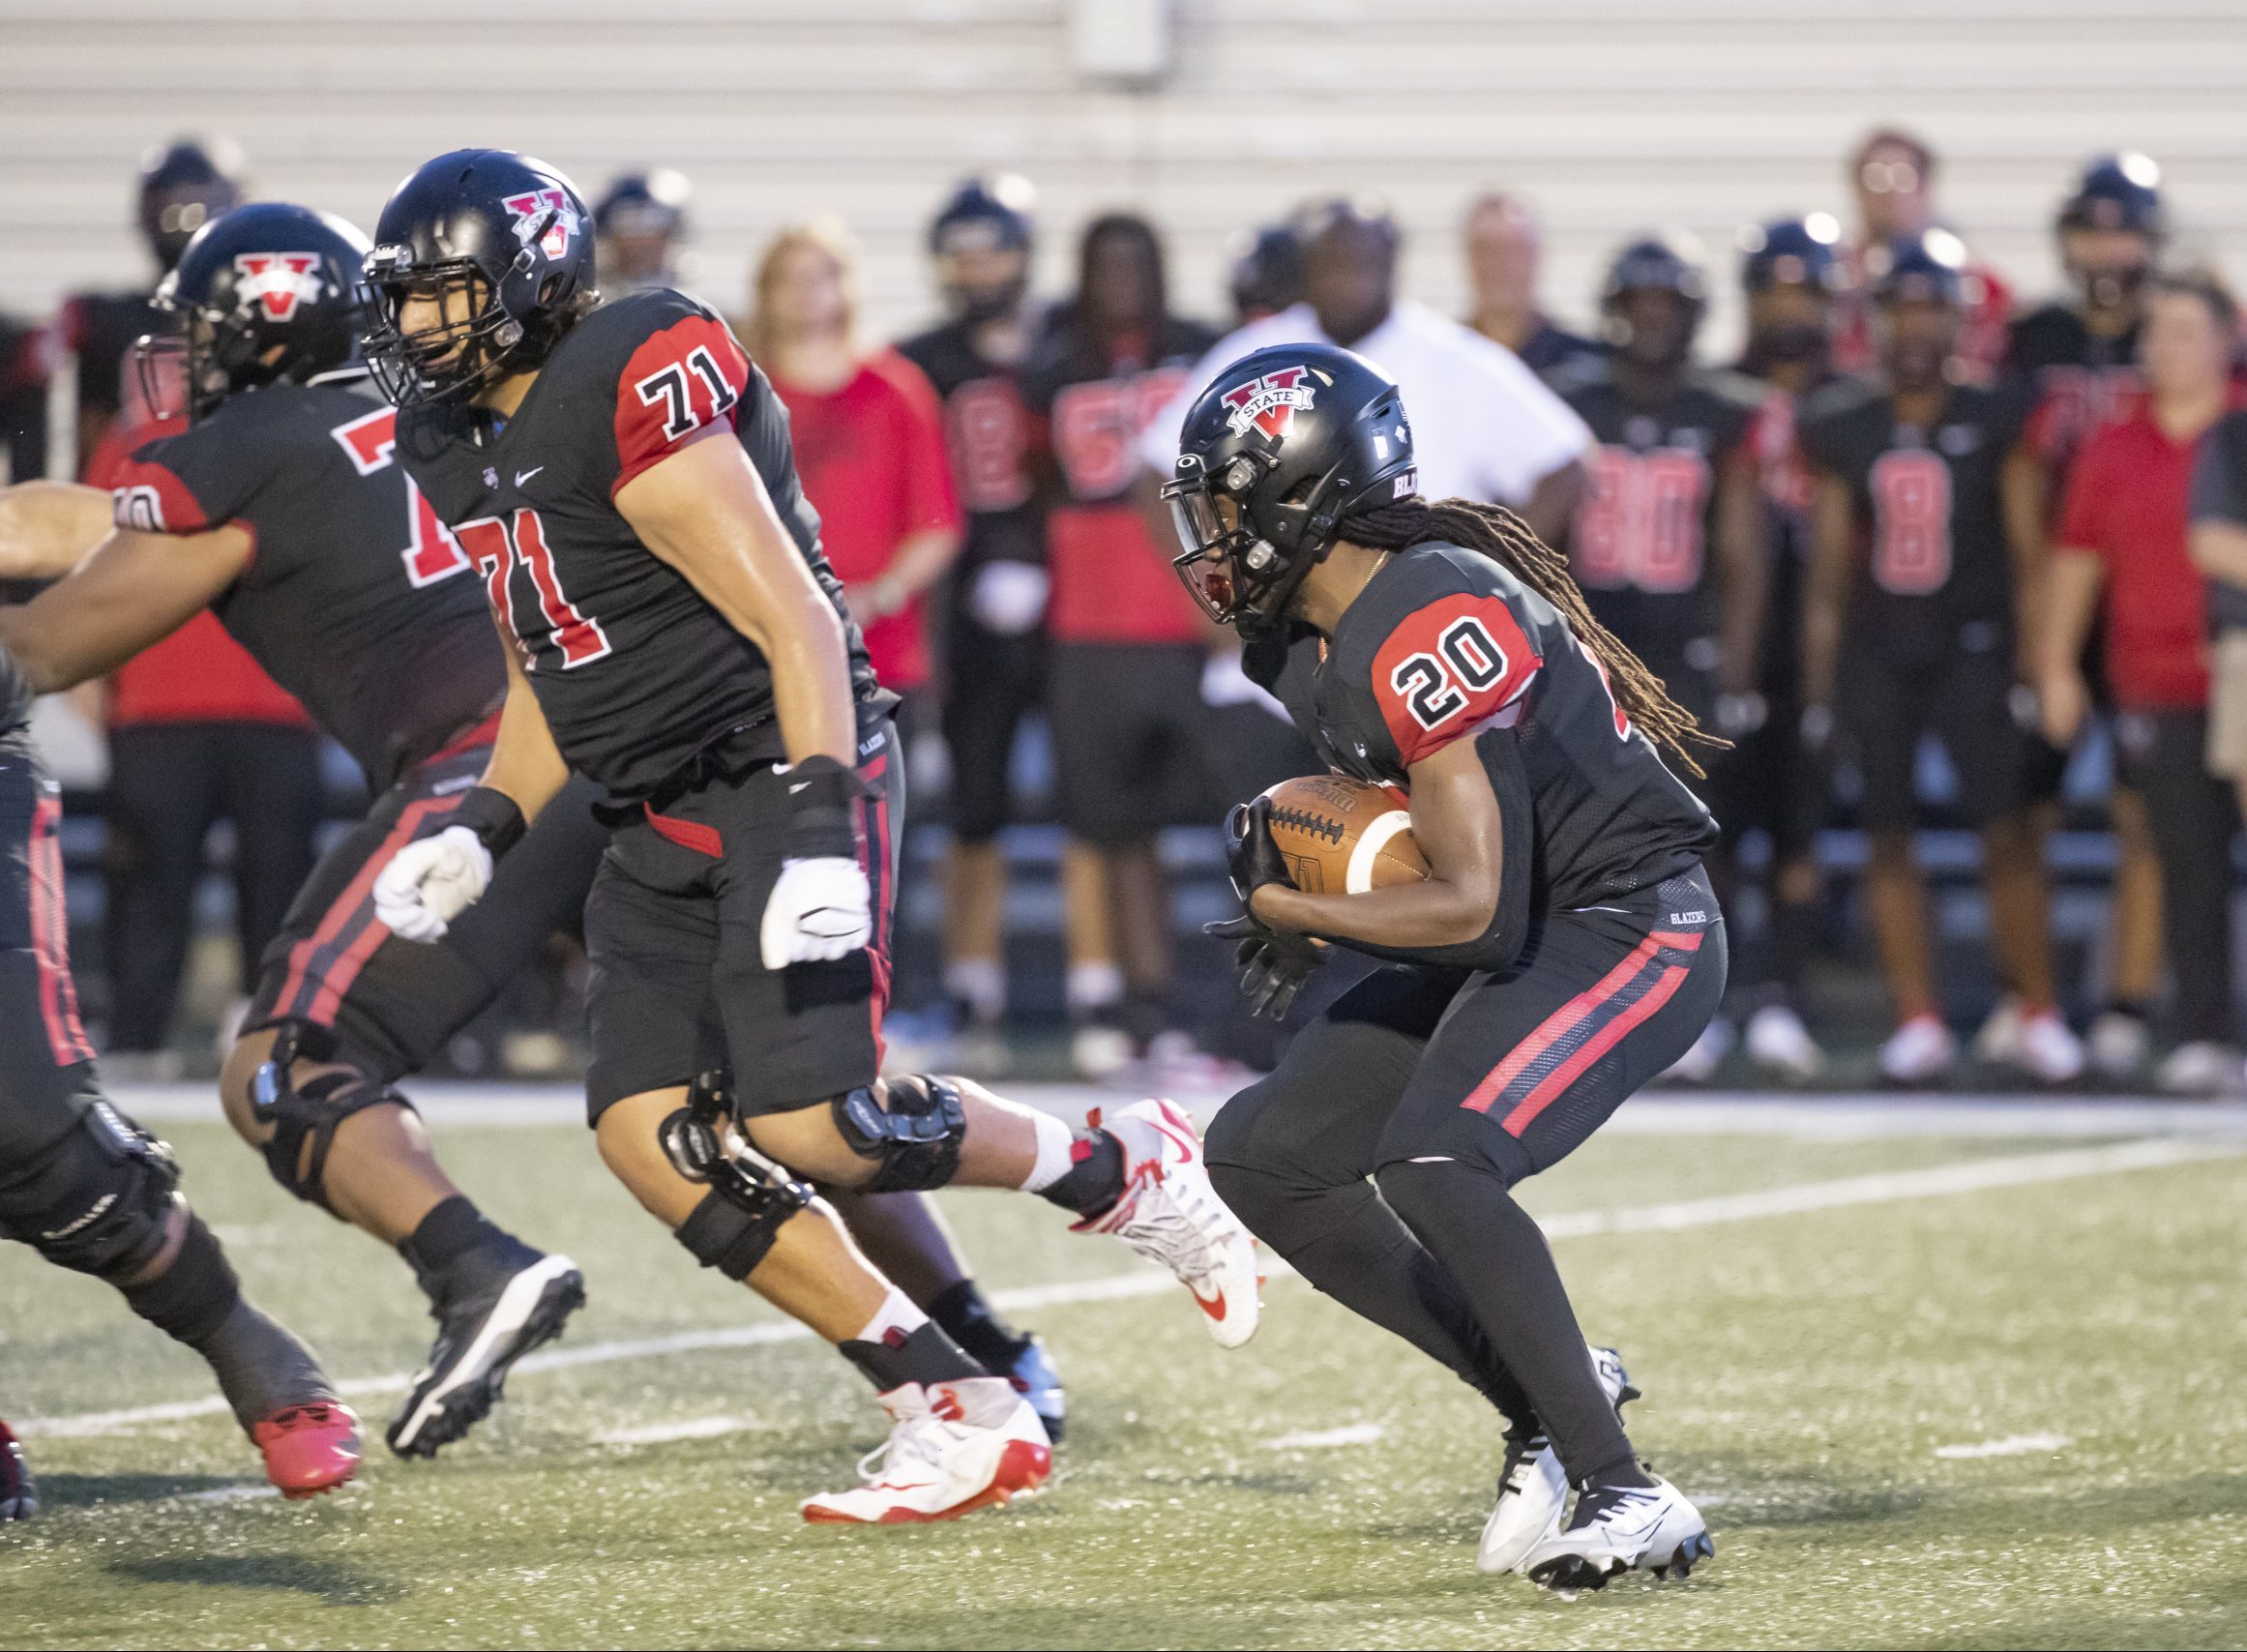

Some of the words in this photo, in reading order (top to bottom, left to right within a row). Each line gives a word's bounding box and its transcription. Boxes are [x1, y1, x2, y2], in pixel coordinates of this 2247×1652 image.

[635, 344, 738, 442] 71
[1244, 391, 1294, 418] STATE
[449, 507, 613, 670] 71
[1390, 615, 1509, 732] 20
[1670, 910, 1707, 925] BLAZERS
